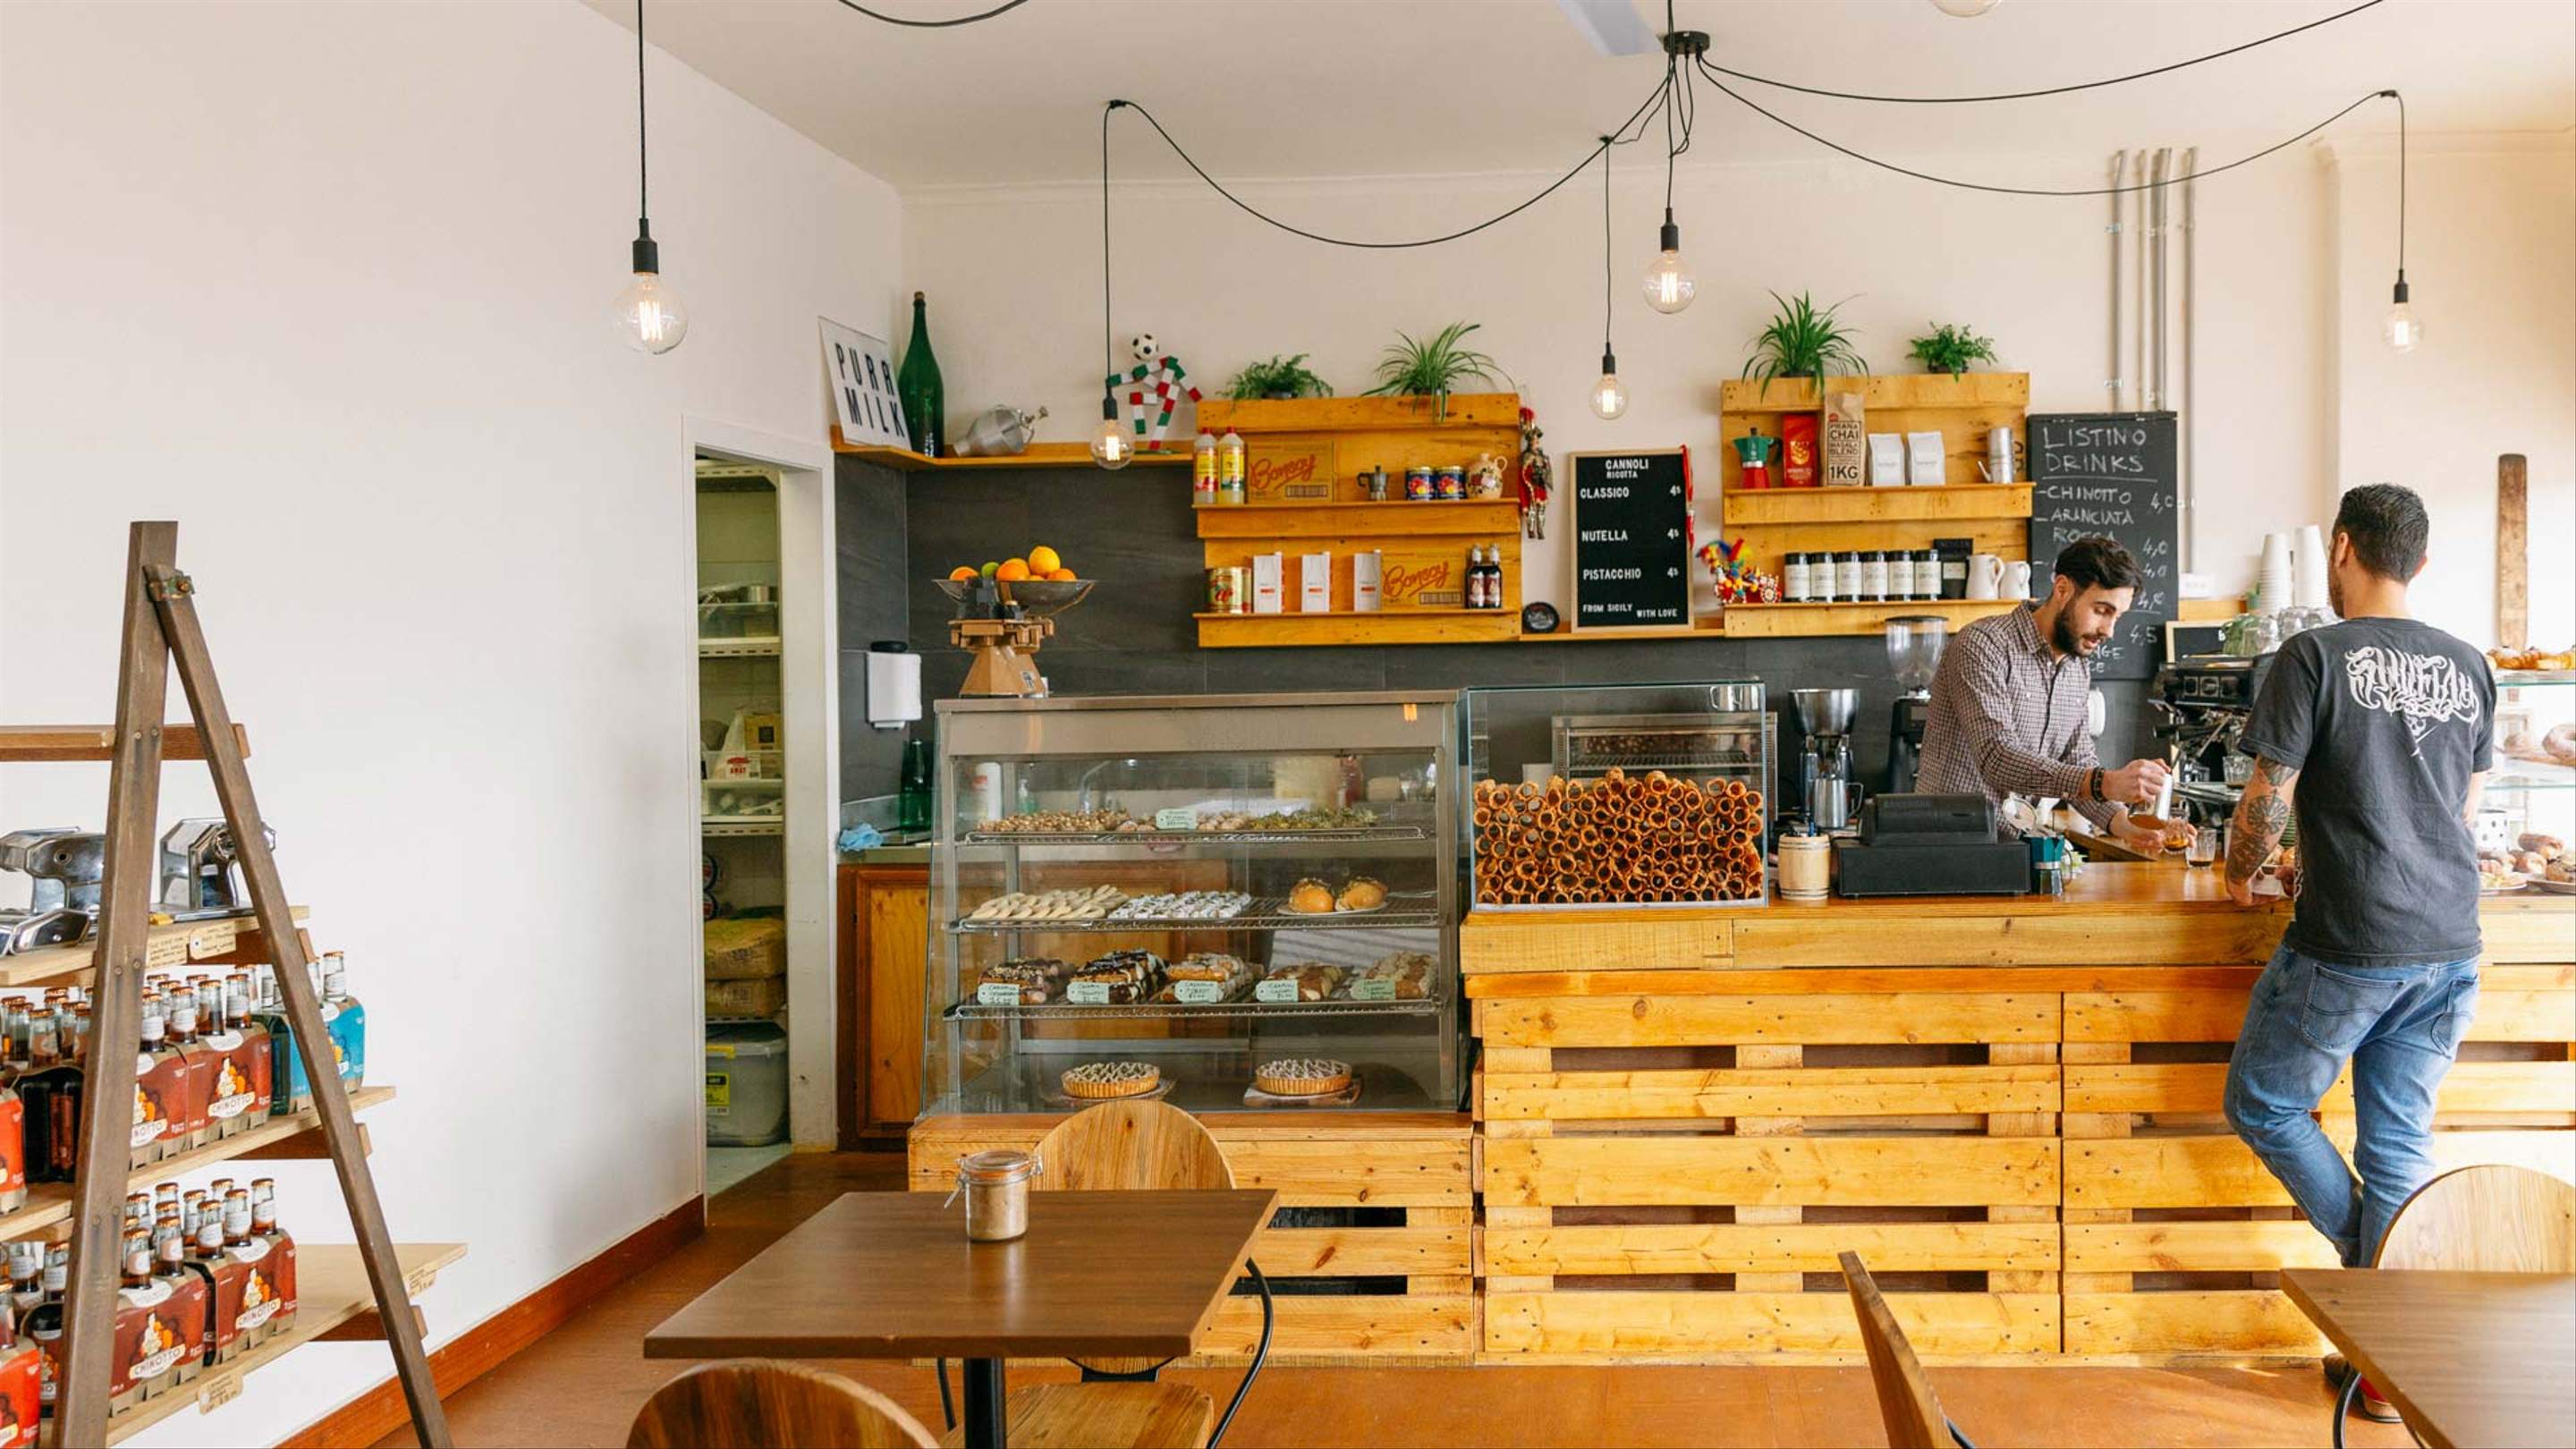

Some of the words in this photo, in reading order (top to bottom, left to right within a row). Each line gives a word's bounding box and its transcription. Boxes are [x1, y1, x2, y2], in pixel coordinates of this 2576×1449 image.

[844, 386, 905, 438] MILK
[1830, 429, 1859, 440] CHAI
[2043, 427, 2147, 449] LISTINO
[1606, 459, 1649, 470] CANNOLI
[2046, 453, 2144, 473] DRINKS
[1606, 470, 1638, 479] RICOTTA
[1830, 466, 1859, 479] 1KG
[1580, 487, 1630, 498] CLASSICO
[1581, 530, 1628, 542] NUTELLA
[1583, 568, 1641, 580] PISTACCHIO
[1582, 604, 1604, 613] FROM
[1607, 603, 1632, 612] SICILY
[1636, 609, 1656, 618] WITH
[1657, 608, 1678, 617] LOVE
[212, 1094, 252, 1114] CHINOTTO
[237, 1300, 278, 1326] CHINOTTO
[133, 1347, 182, 1376] CHINOTTO
